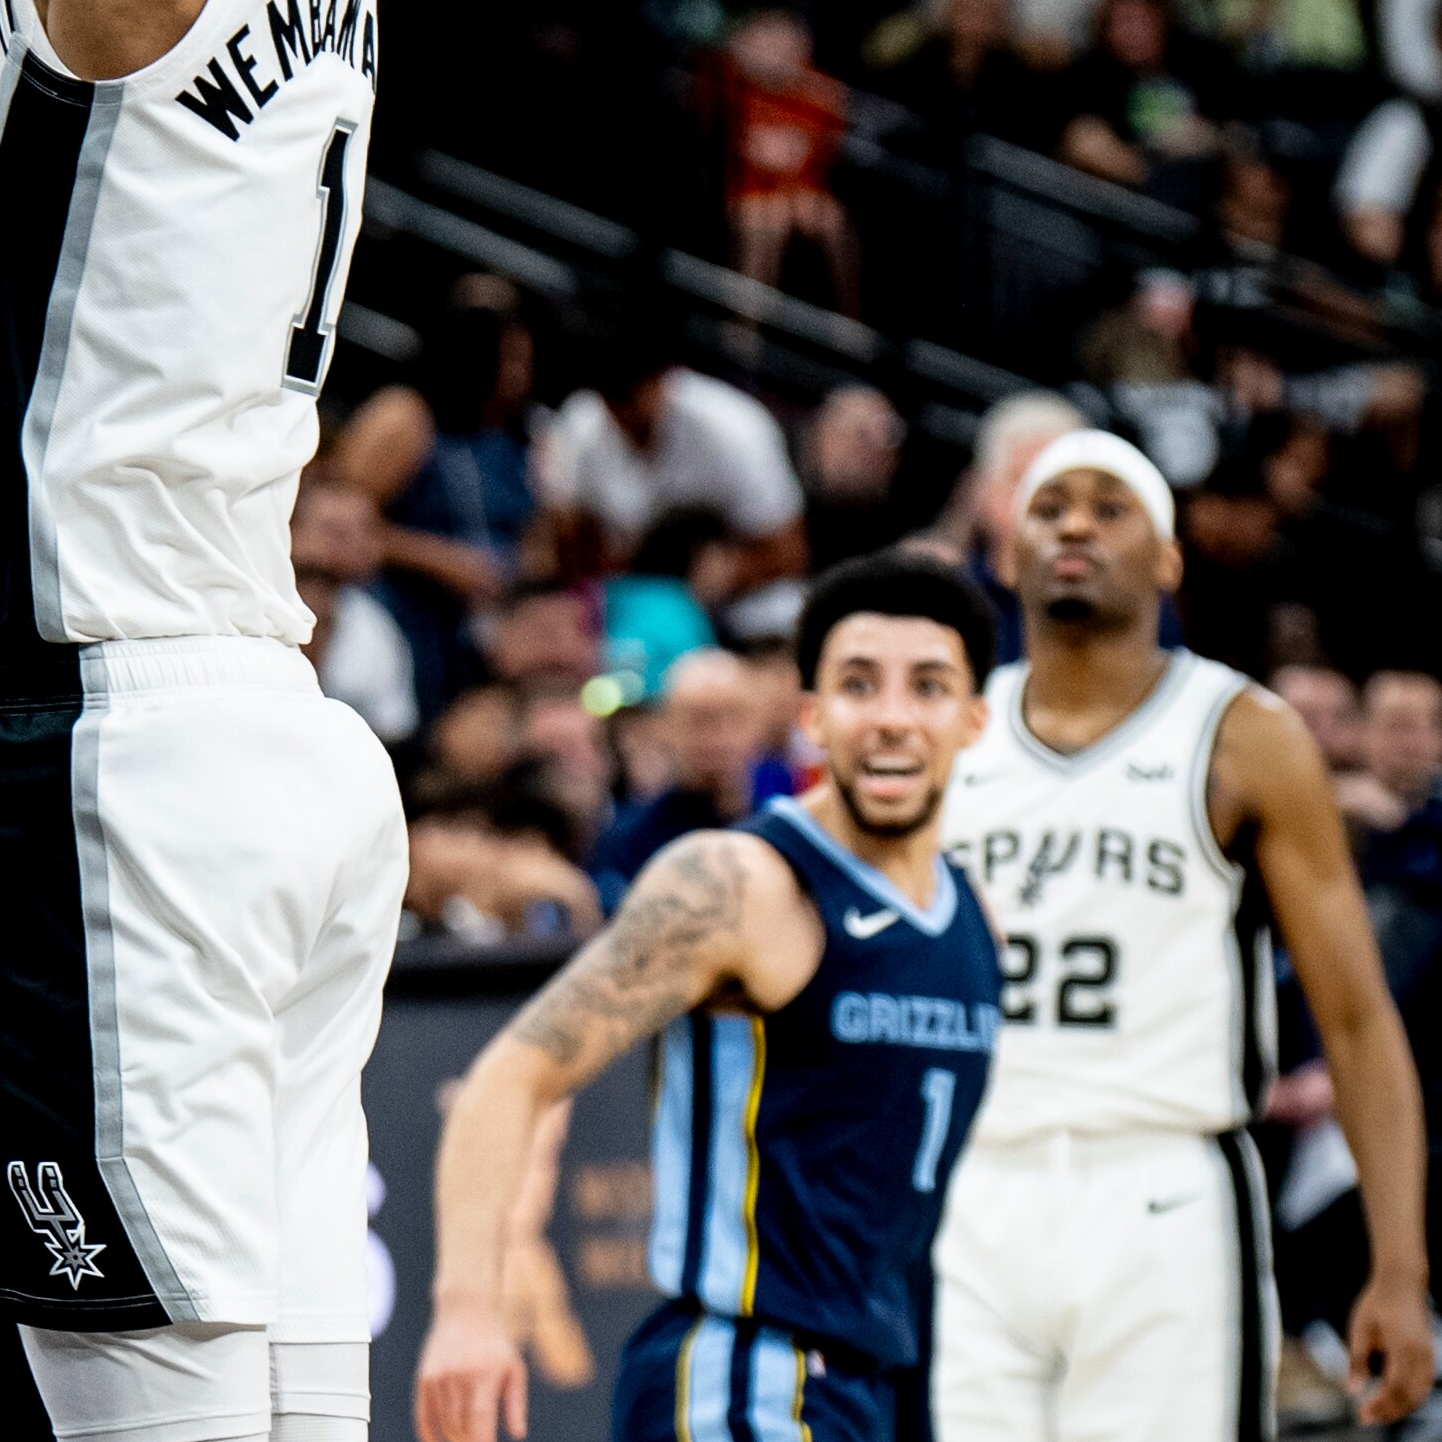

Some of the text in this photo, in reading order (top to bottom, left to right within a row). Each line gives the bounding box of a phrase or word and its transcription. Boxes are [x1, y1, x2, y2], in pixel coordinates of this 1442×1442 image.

[281, 116, 358, 397] 1
[949, 826, 1188, 906] PURS
[830, 991, 1000, 1052] GRIZZLI
[1001, 931, 1122, 1027] 22
[912, 1067, 958, 1193] 1
